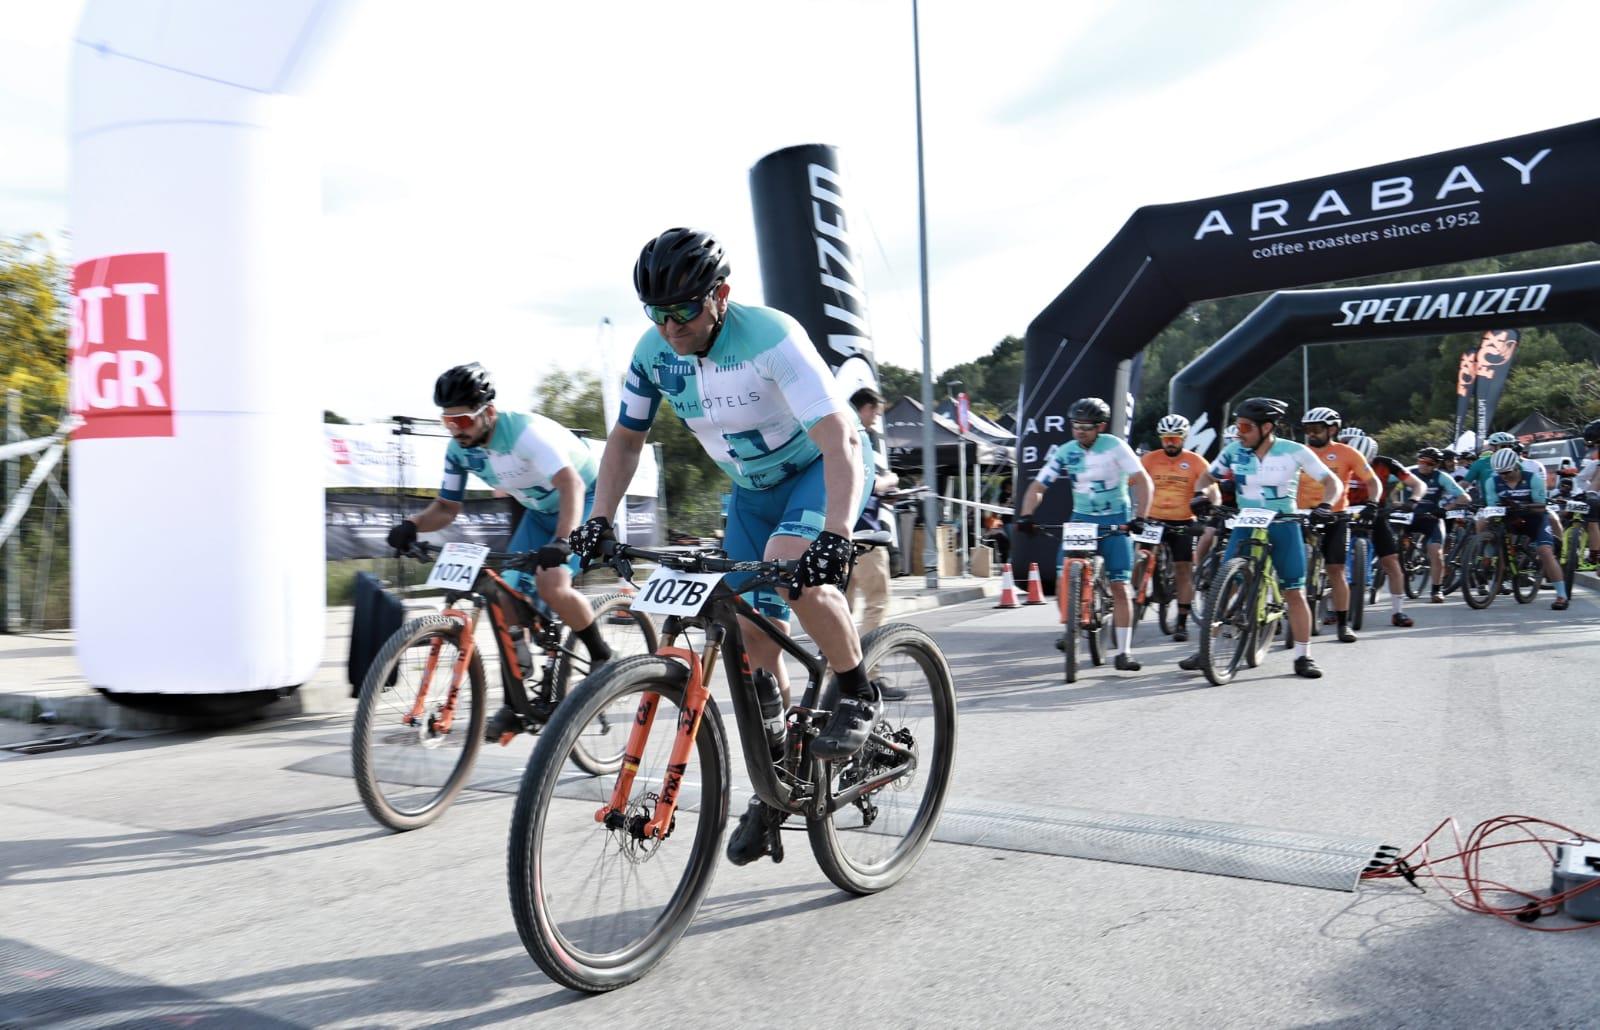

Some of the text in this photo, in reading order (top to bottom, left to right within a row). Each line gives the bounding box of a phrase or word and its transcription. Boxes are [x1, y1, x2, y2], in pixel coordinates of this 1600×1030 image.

[1194, 148, 1552, 241] ARABAY
[1252, 211, 1481, 259] coffee roasters since 1952
[807, 162, 873, 374] ALIZED
[1332, 284, 1552, 326] SPECIALIZED
[668, 392, 760, 412] MHOTELS
[435, 563, 472, 583] 107A
[643, 579, 708, 606] 107B
